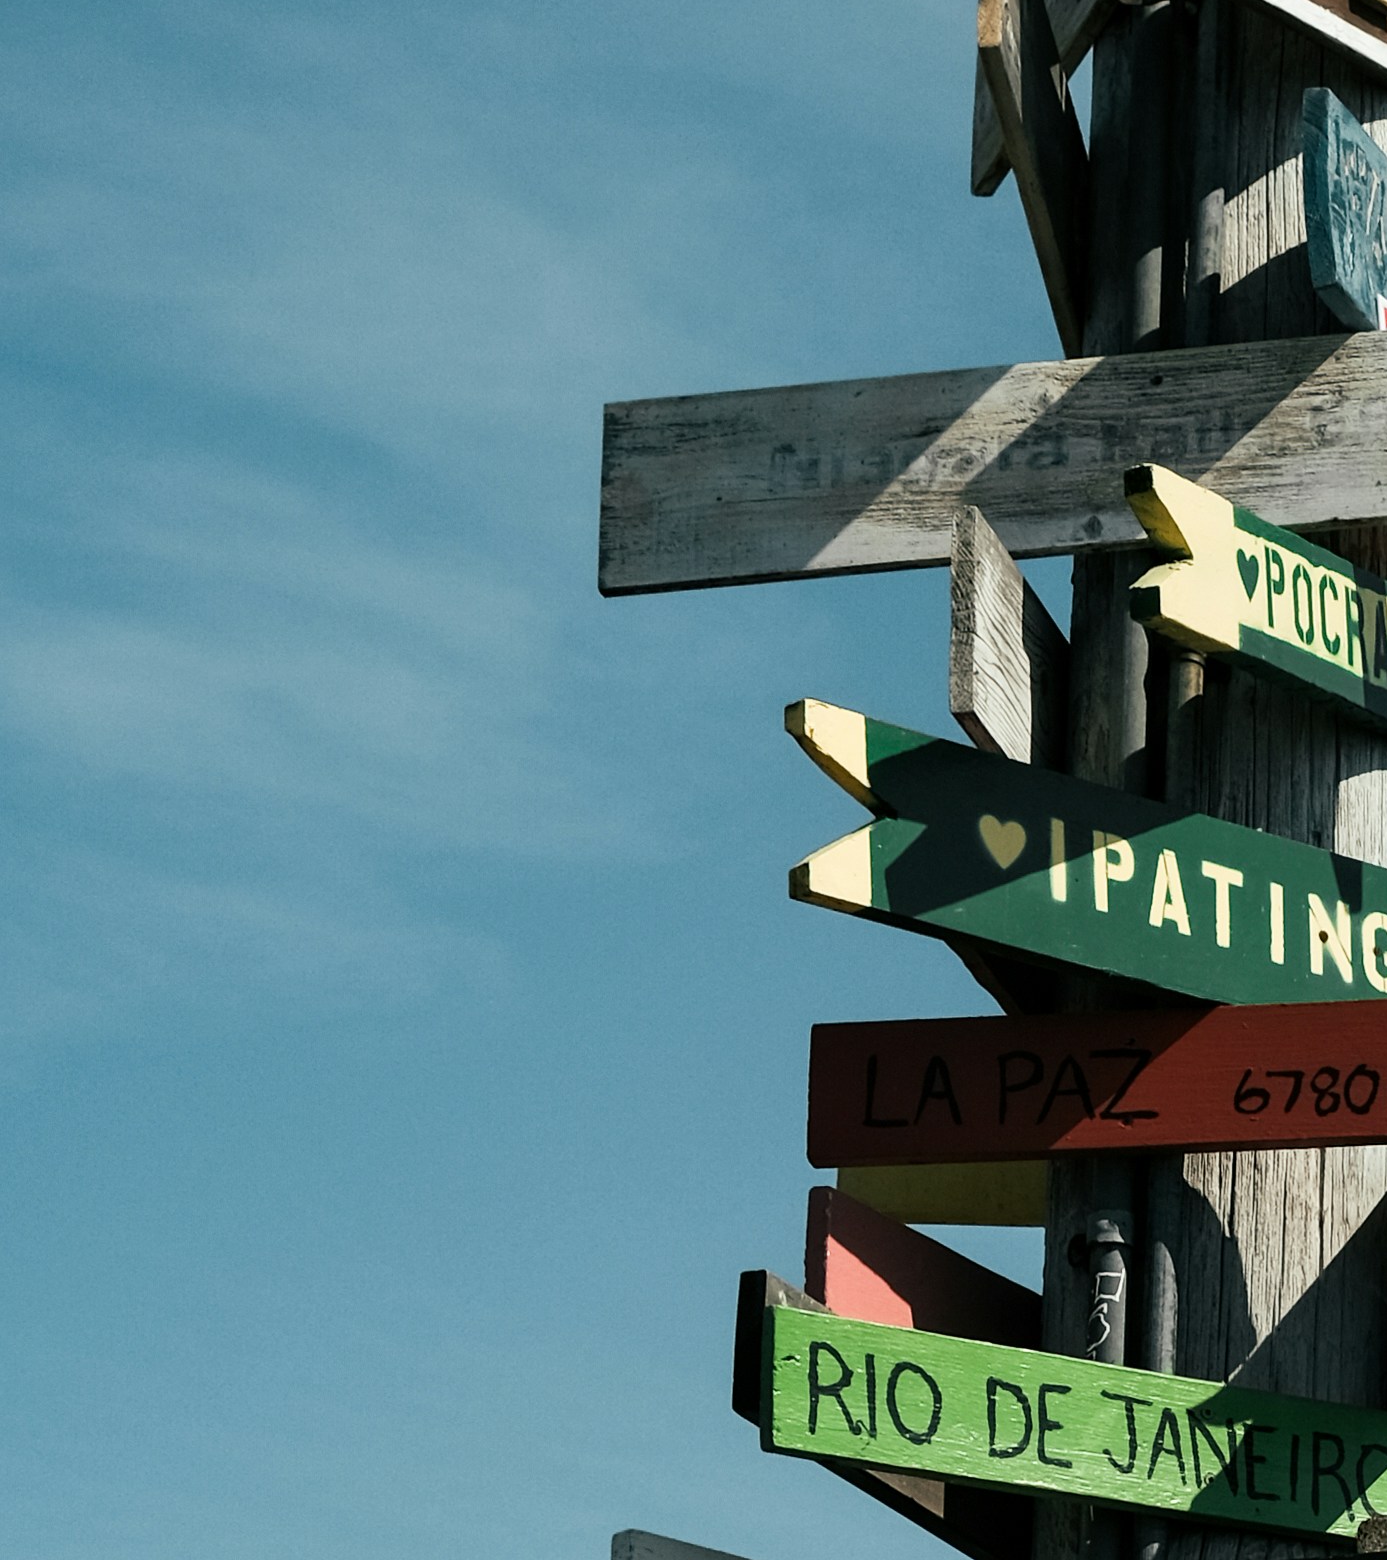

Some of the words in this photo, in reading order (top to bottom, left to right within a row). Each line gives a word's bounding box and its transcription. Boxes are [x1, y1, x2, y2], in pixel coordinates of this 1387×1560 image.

[862, 1053, 962, 1129] LA
[999, 1044, 1159, 1127] PAZ
[1232, 1064, 1380, 1116] 6780
[807, 1341, 944, 1446] RIO
[987, 1379, 1073, 1469] DE
